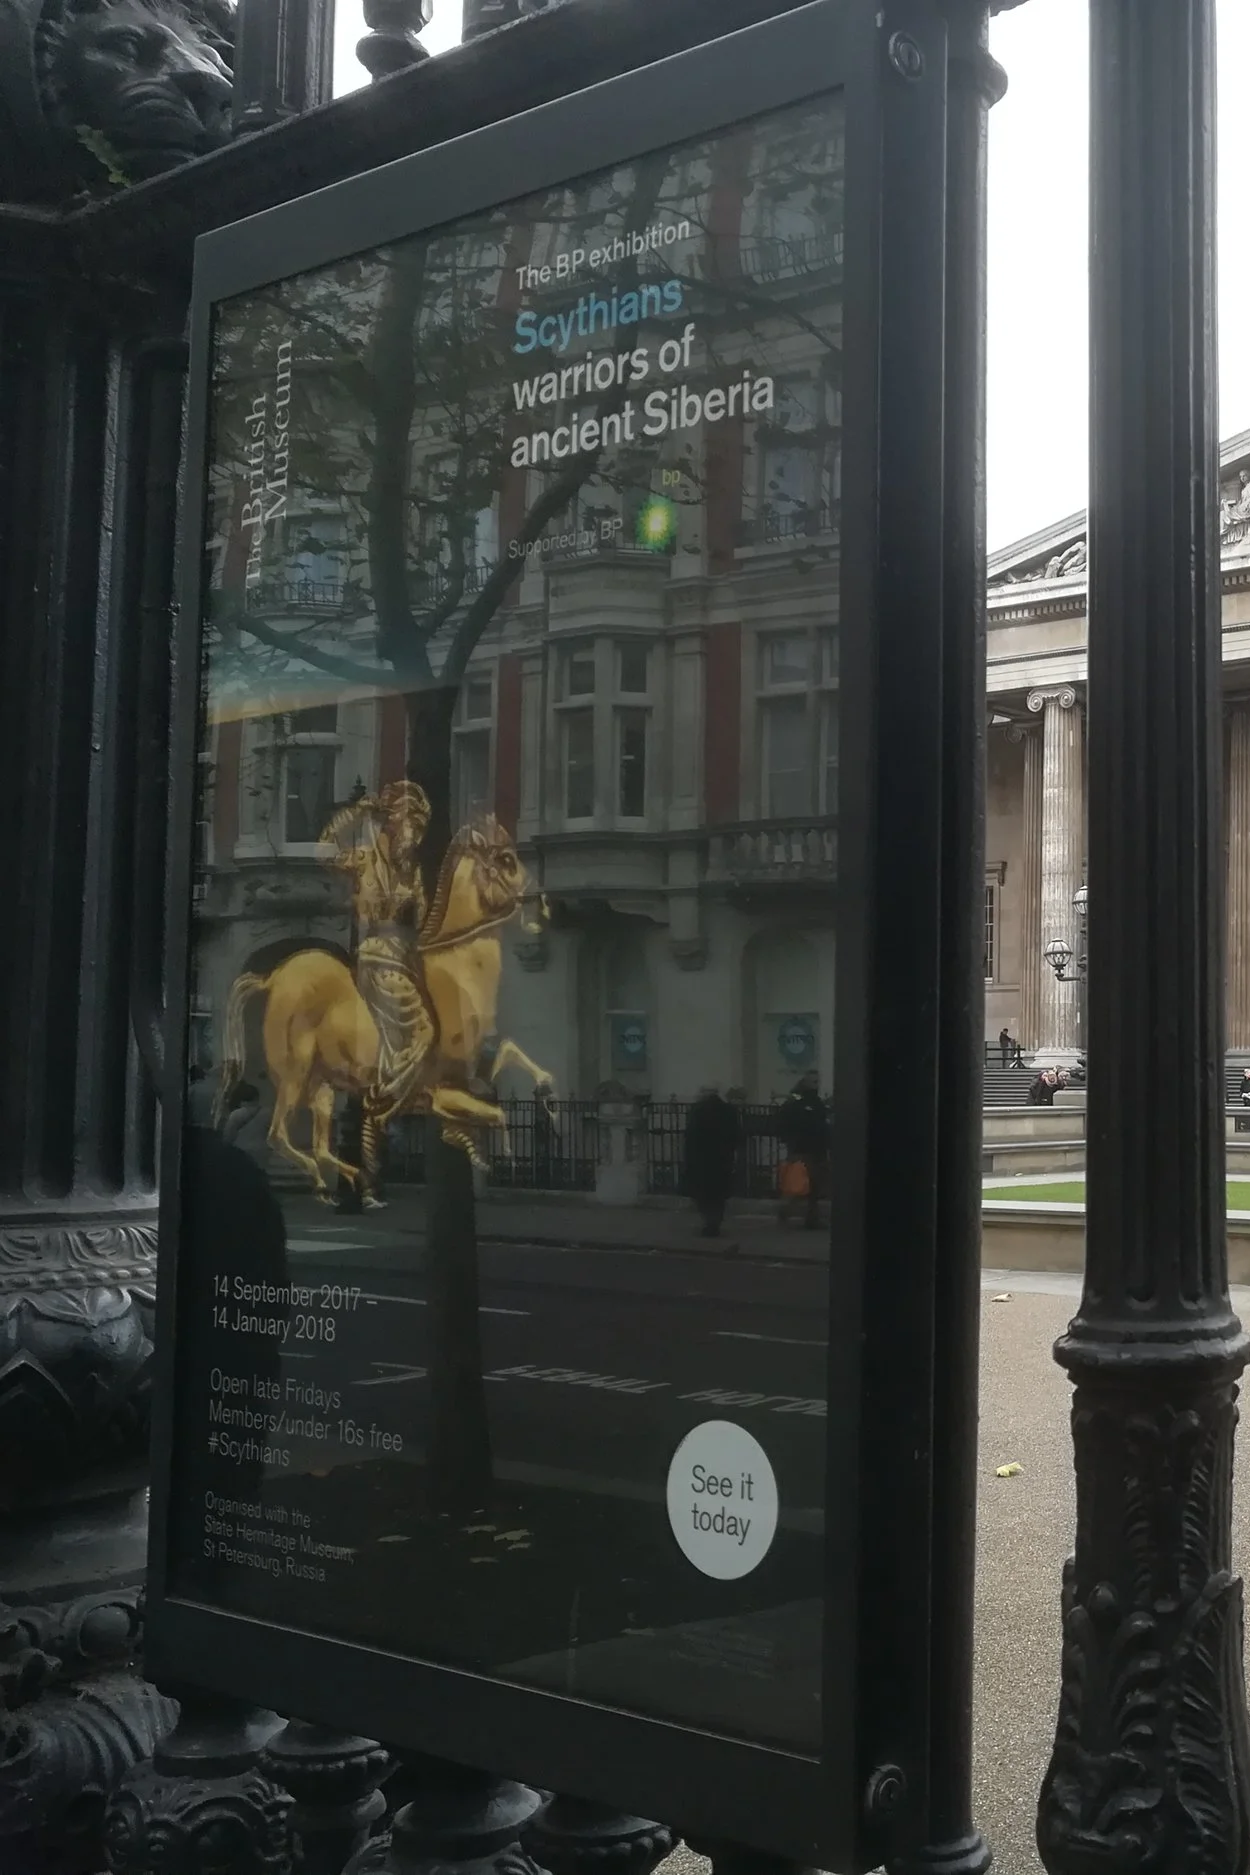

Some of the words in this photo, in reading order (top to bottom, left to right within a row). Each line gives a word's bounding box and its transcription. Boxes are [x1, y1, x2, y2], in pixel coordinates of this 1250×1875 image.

[515, 261, 551, 290] The
[556, 249, 584, 280] BP
[588, 220, 690, 268] exhibition
[513, 279, 683, 354] Scythians
[512, 350, 649, 411] warriors
[659, 322, 696, 373] of
[264, 339, 293, 522] Museum
[510, 400, 635, 468] ancient
[642, 369, 775, 437] Siberia
[241, 392, 267, 532] British
[662, 468, 681, 486] bp
[508, 530, 576, 559] Supported
[579, 529, 599, 549] by
[600, 518, 623, 541] BP
[212, 1274, 229, 1297] 14
[233, 1277, 314, 1308] September
[212, 1306, 228, 1329] 14
[231, 1308, 291, 1344] January
[295, 1314, 336, 1342] 2018
[210, 1368, 249, 1397] Open
[253, 1373, 281, 1399] late
[285, 1378, 342, 1413] Fridays
[209, 1399, 330, 1441] Members/under
[338, 1419, 365, 1447] 16s
[369, 1423, 404, 1452] free
[207, 1431, 290, 1467] #Scythians
[691, 1464, 733, 1498] See
[740, 1472, 754, 1501] it
[204, 1490, 262, 1517] Organised
[264, 1504, 288, 1524] with
[291, 1507, 311, 1529] the
[691, 1503, 751, 1546] today
[204, 1514, 234, 1537] State
[236, 1521, 297, 1554] Hermitage
[286, 1556, 326, 1583] Russia
